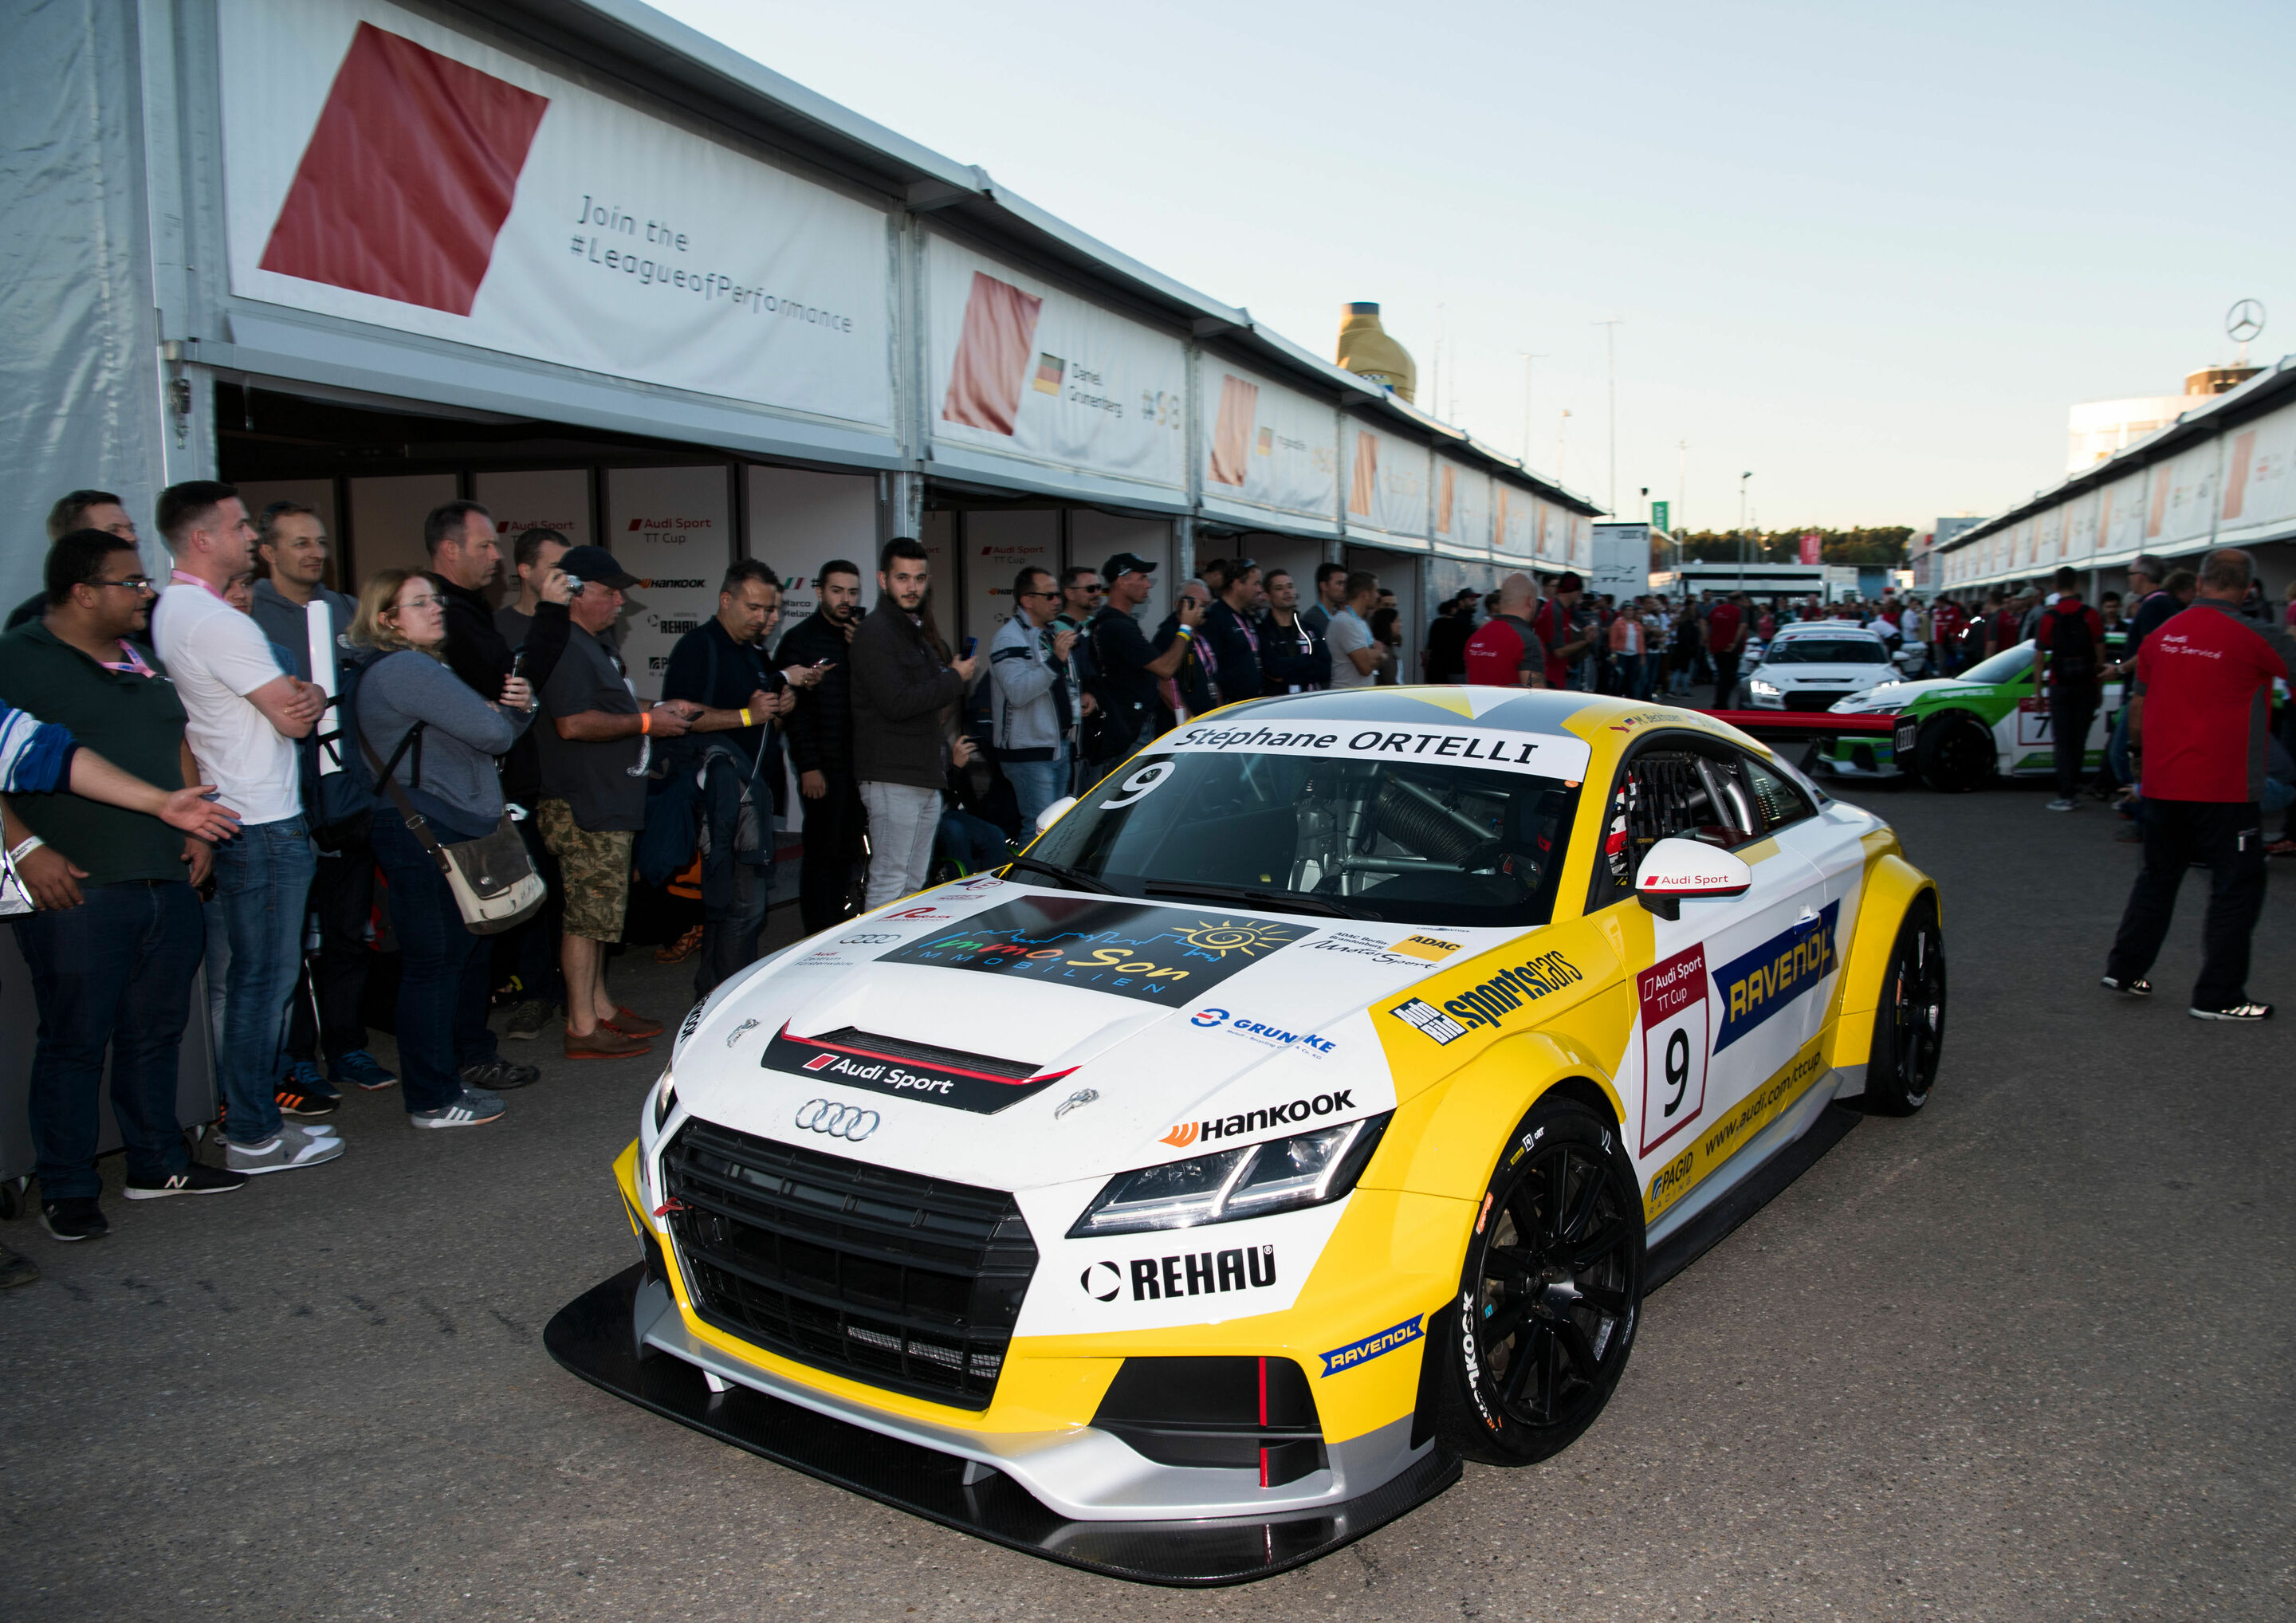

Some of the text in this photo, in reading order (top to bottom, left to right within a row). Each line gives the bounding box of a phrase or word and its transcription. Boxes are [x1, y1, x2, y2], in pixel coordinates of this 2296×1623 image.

[577, 195, 690, 251] Join the
[569, 235, 853, 333] #LeagueofPerformance
[643, 517, 712, 530] Audi Sport
[643, 532, 686, 545] TT Cup
[1007, 556, 1025, 565] Cup
[1017, 546, 1044, 556] Sport
[2160, 644, 2179, 654] Top
[2163, 634, 2188, 643] Audi
[1174, 727, 1539, 765] Stéphane ORTELLI
[1099, 760, 1177, 810] 9
[1661, 874, 1728, 886] Audi Sport
[1328, 935, 1386, 950] Brandenburg
[1408, 933, 1461, 951] ADAC
[901, 949, 1166, 995] IMMOBILIEN
[1655, 955, 1703, 991] Audi Sport
[1657, 986, 1688, 1013] TT Cup
[832, 1058, 954, 1095] Audi Sport
[1663, 1027, 1690, 1118] 9
[1705, 1051, 1821, 1157] www.audi.com/ttcup
[1661, 1151, 1693, 1194] PAGID
